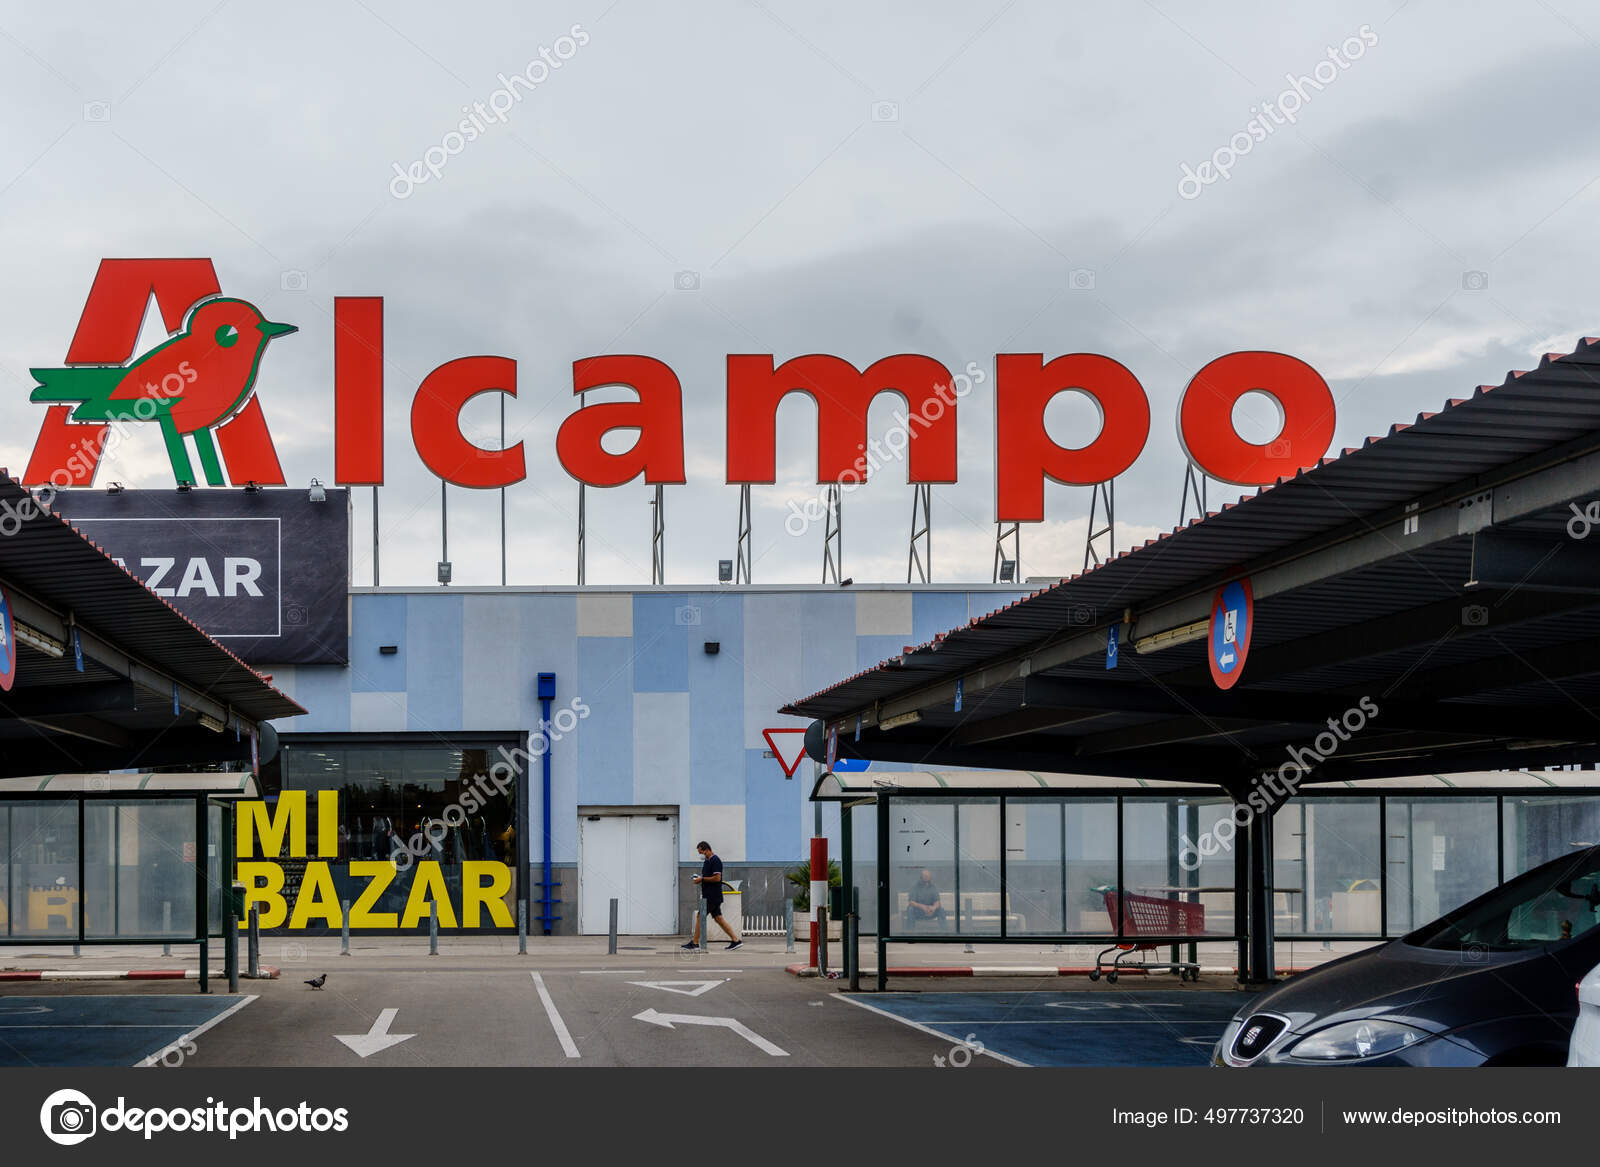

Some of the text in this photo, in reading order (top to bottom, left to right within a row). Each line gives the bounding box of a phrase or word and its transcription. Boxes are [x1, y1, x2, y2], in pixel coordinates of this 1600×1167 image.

[22, 257, 1337, 522] Alcampo
[112, 557, 264, 597] ZAR
[236, 789, 339, 858] MI
[237, 859, 515, 930] BAZAR
